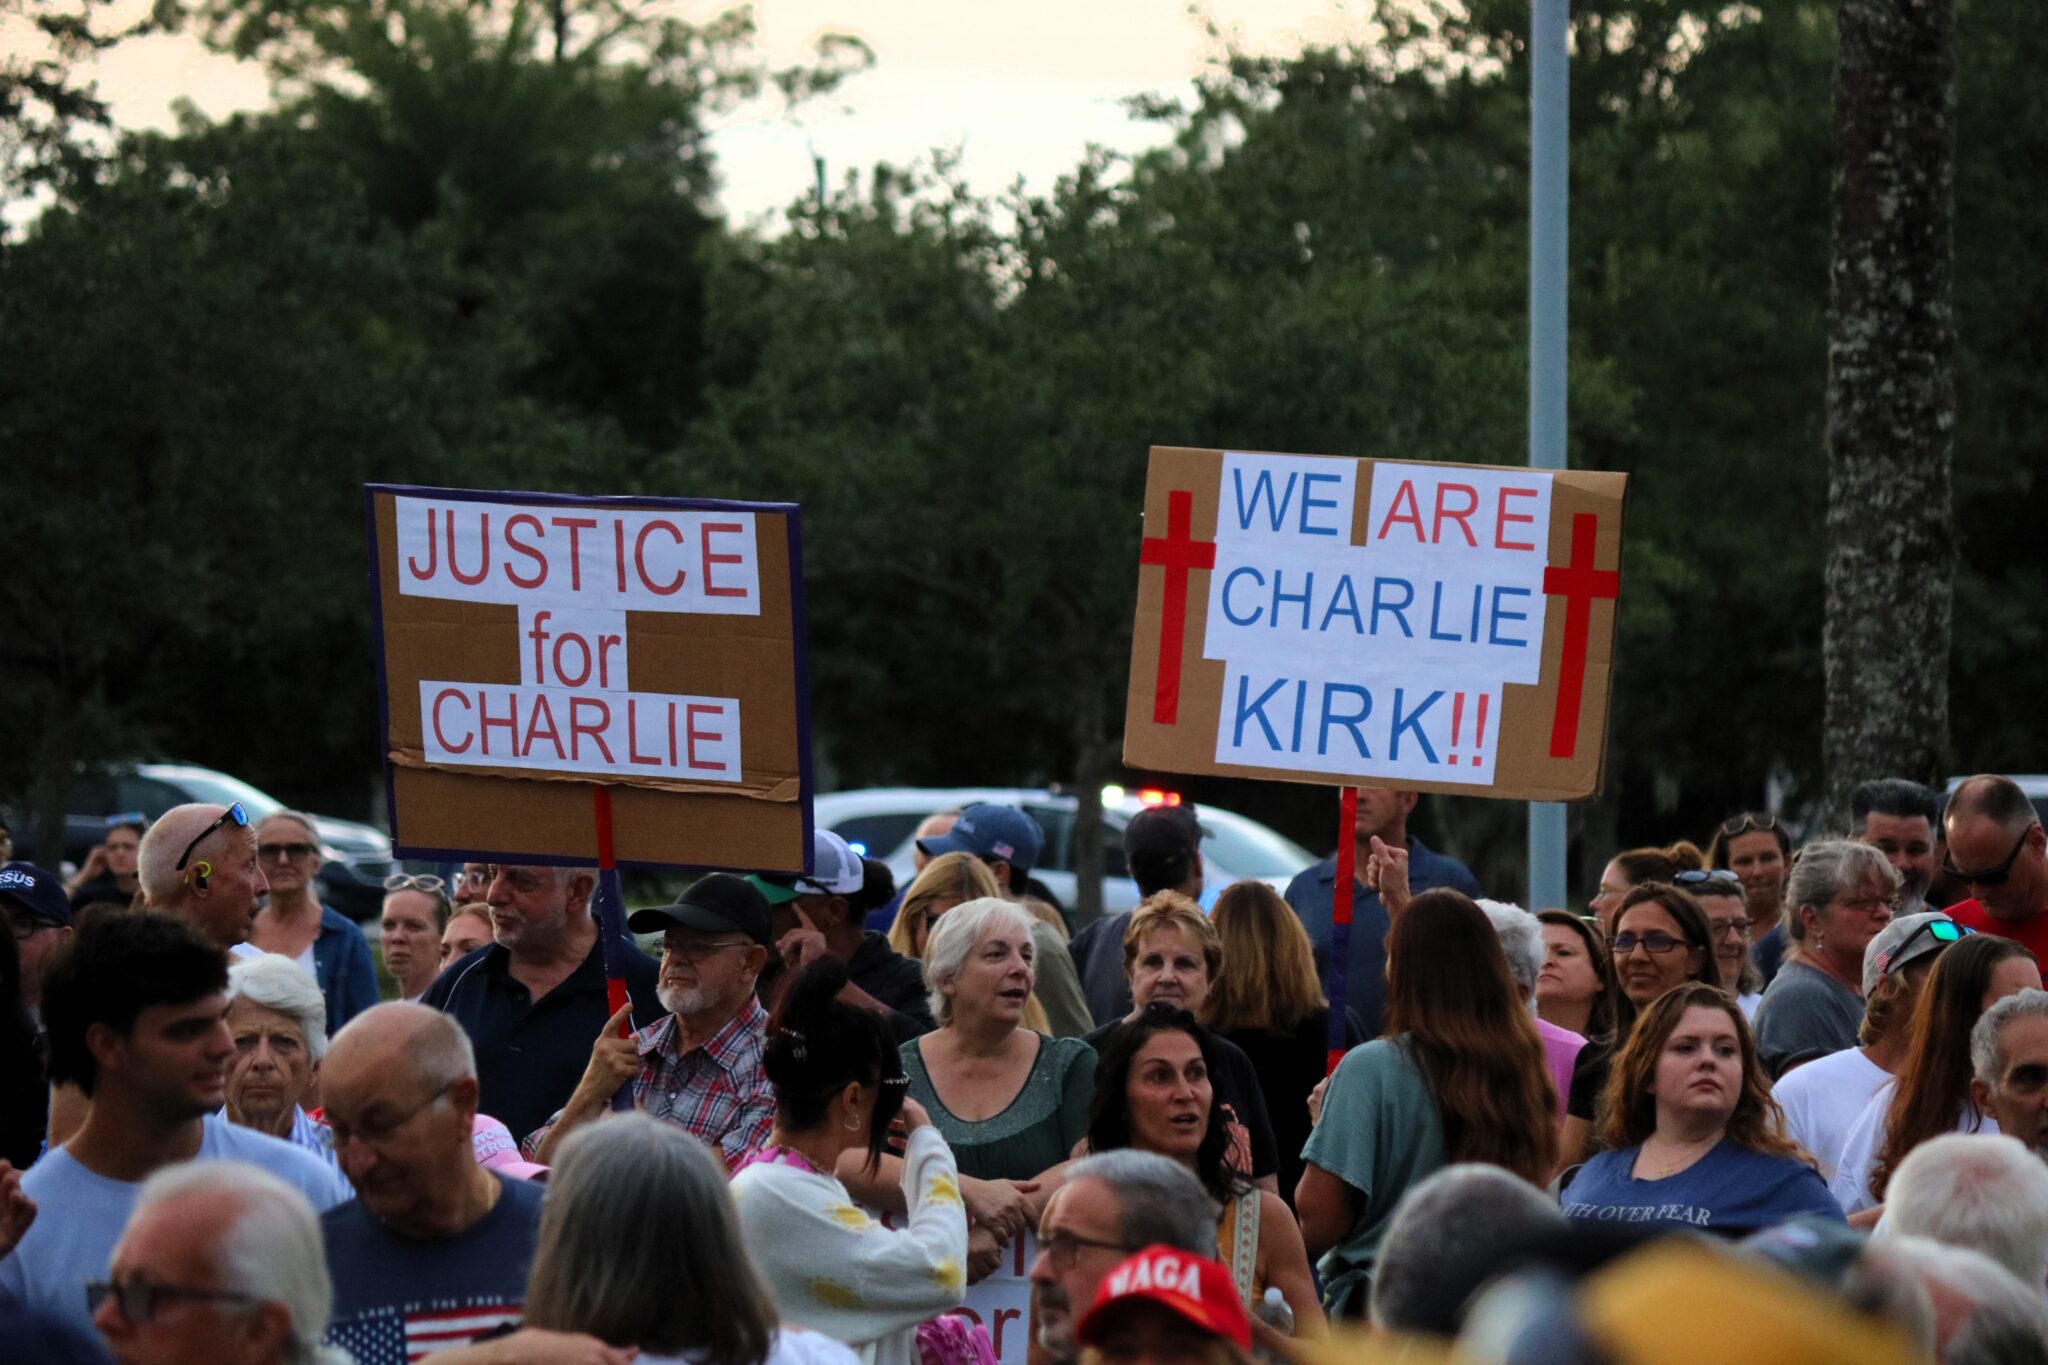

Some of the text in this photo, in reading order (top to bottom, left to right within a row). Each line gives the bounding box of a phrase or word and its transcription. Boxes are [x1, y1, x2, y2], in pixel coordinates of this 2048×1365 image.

[1233, 468, 1539, 552] WE ARE
[408, 507, 748, 598] JUSTICE
[1222, 566, 1532, 648] CHARLIE
[528, 610, 621, 689] for
[432, 688, 727, 771] CHARLIE
[1232, 674, 1490, 768] KIRK!!
[0, 872, 36, 887] ESUS
[1599, 1205, 1655, 1222] OVER
[1656, 1203, 1711, 1226] FEAR
